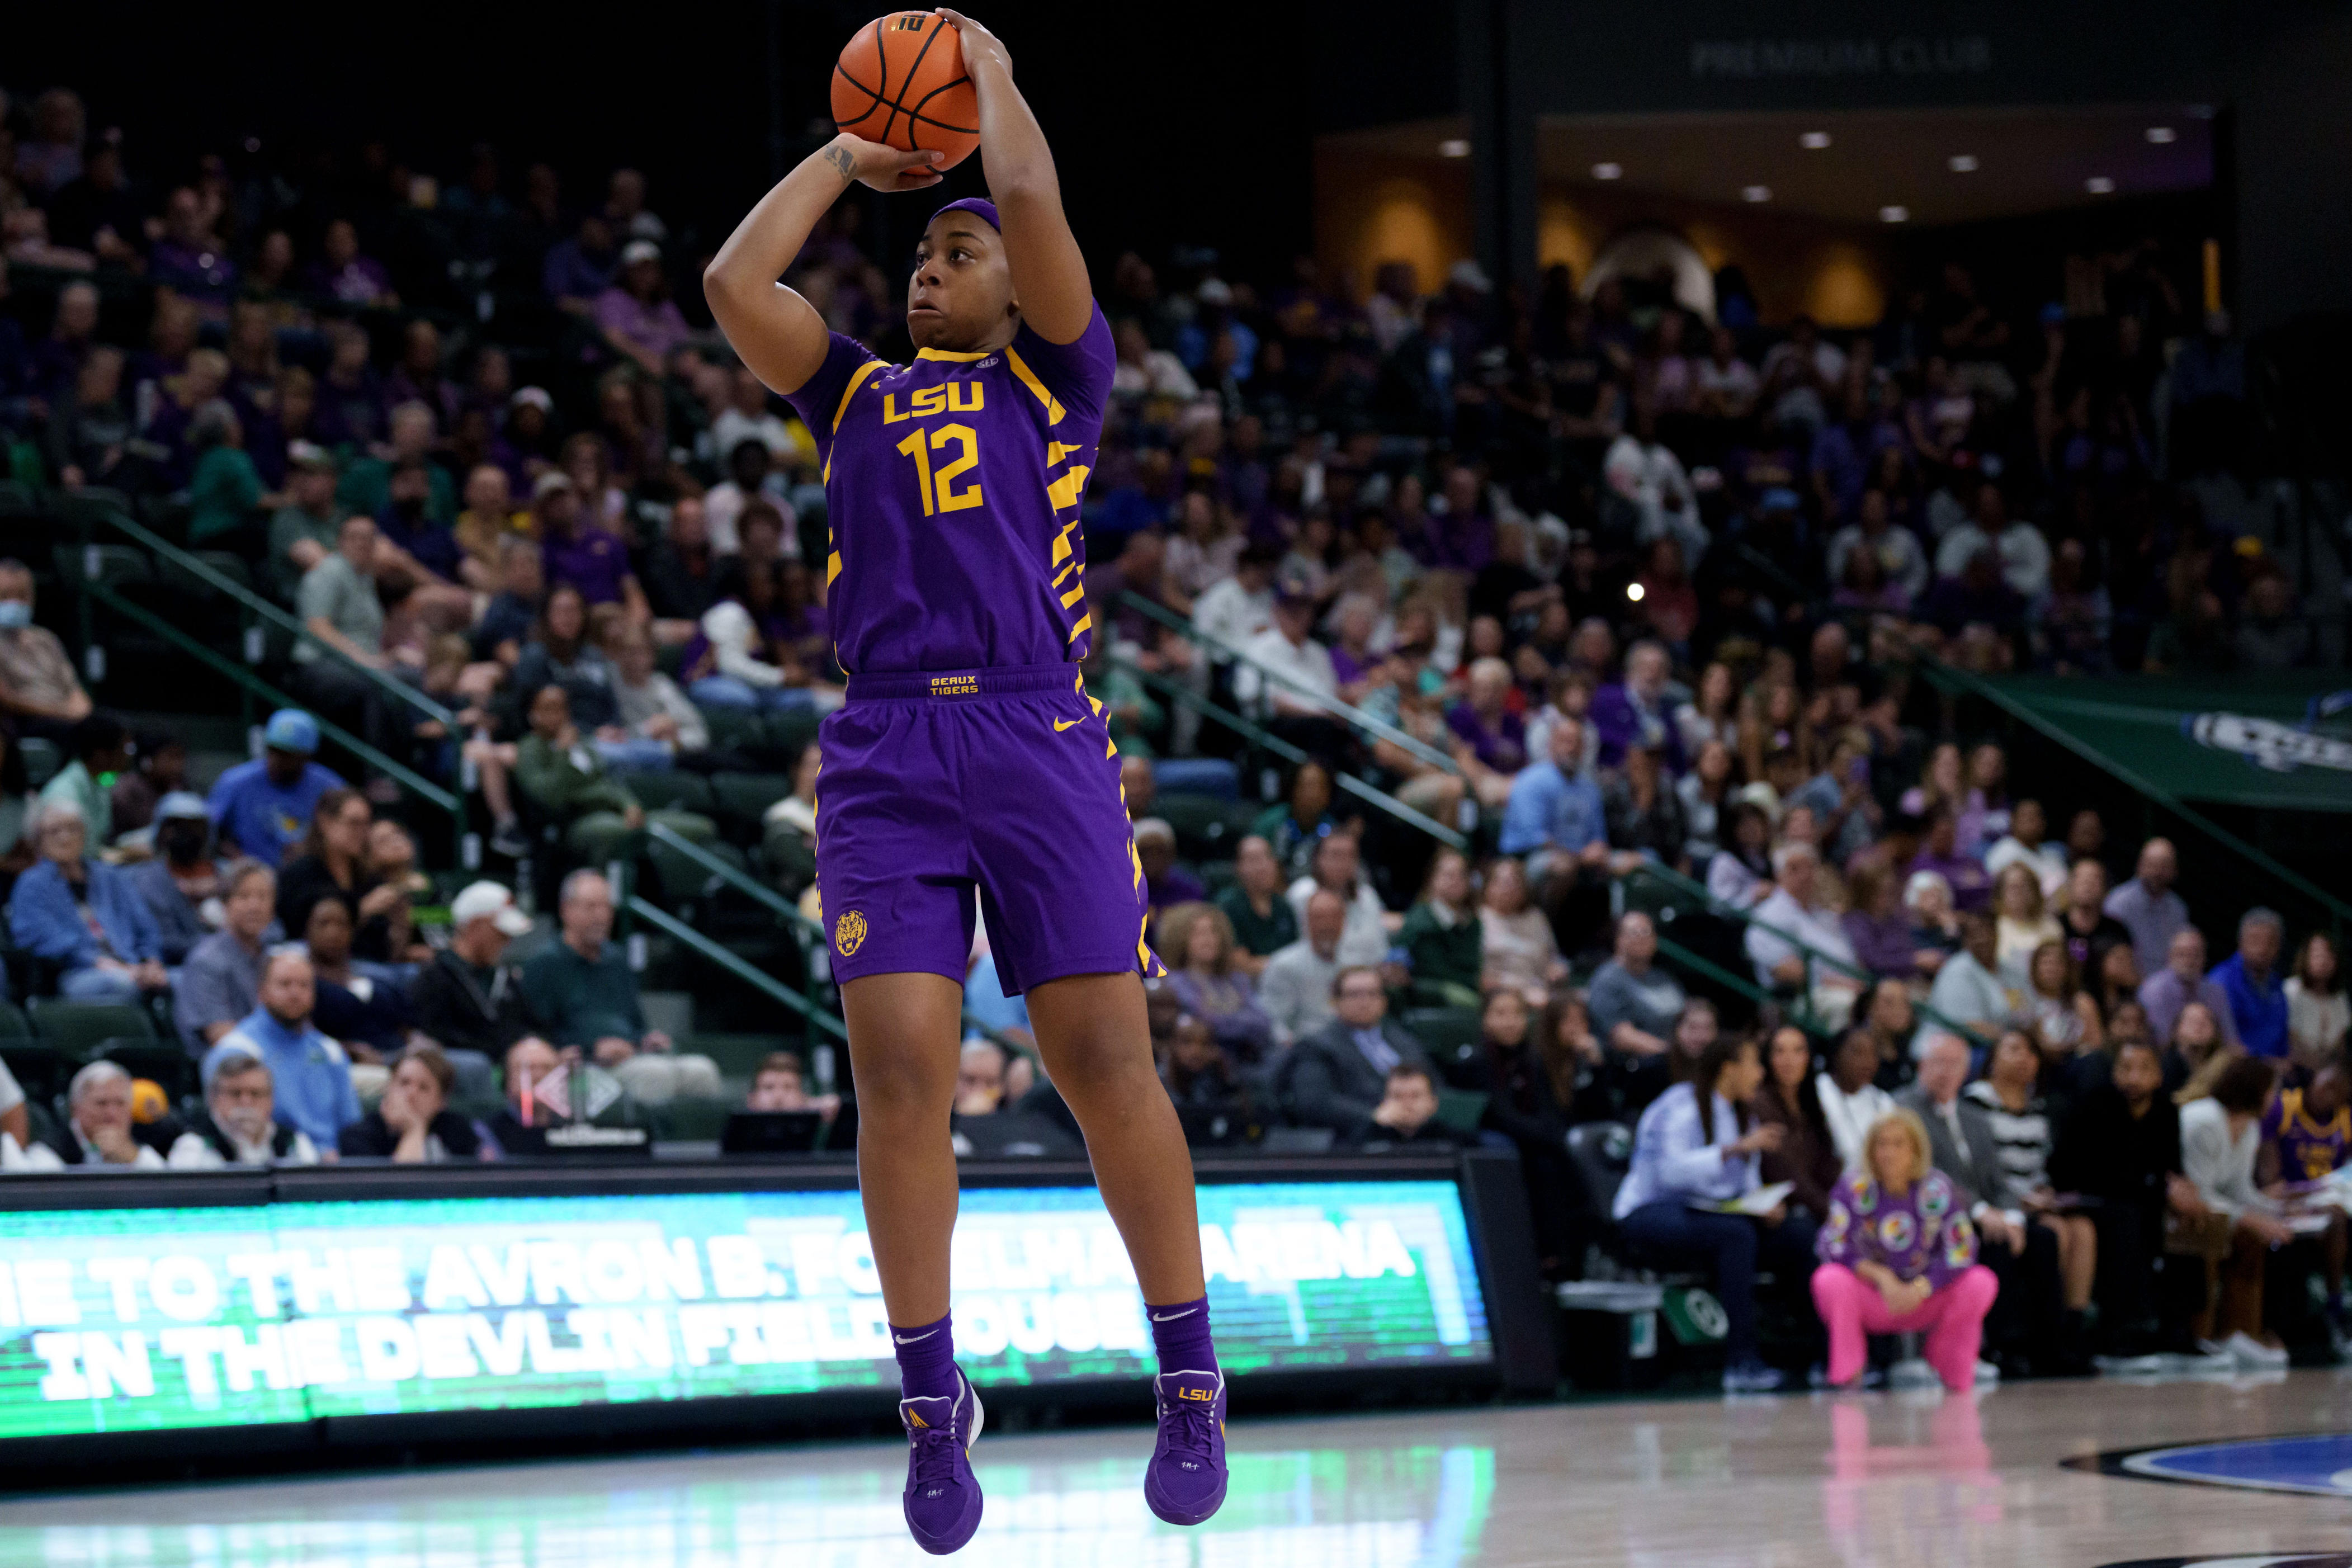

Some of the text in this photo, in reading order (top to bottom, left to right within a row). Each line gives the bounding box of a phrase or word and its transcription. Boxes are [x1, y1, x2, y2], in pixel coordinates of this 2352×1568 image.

[884, 381, 984, 424] LSU
[896, 423, 983, 517] 12
[930, 685, 978, 695] TIGERS
[932, 676, 975, 686] GEAUX
[87, 1255, 219, 1323] TO
[226, 1246, 411, 1317] THE
[423, 1236, 705, 1310] AVRON
[1199, 1219, 1415, 1282] ARENA
[35, 1330, 154, 1400] IN
[159, 1320, 350, 1392] THE
[356, 1305, 672, 1380] DEVLIN
[1178, 1387, 1212, 1401] LSU
